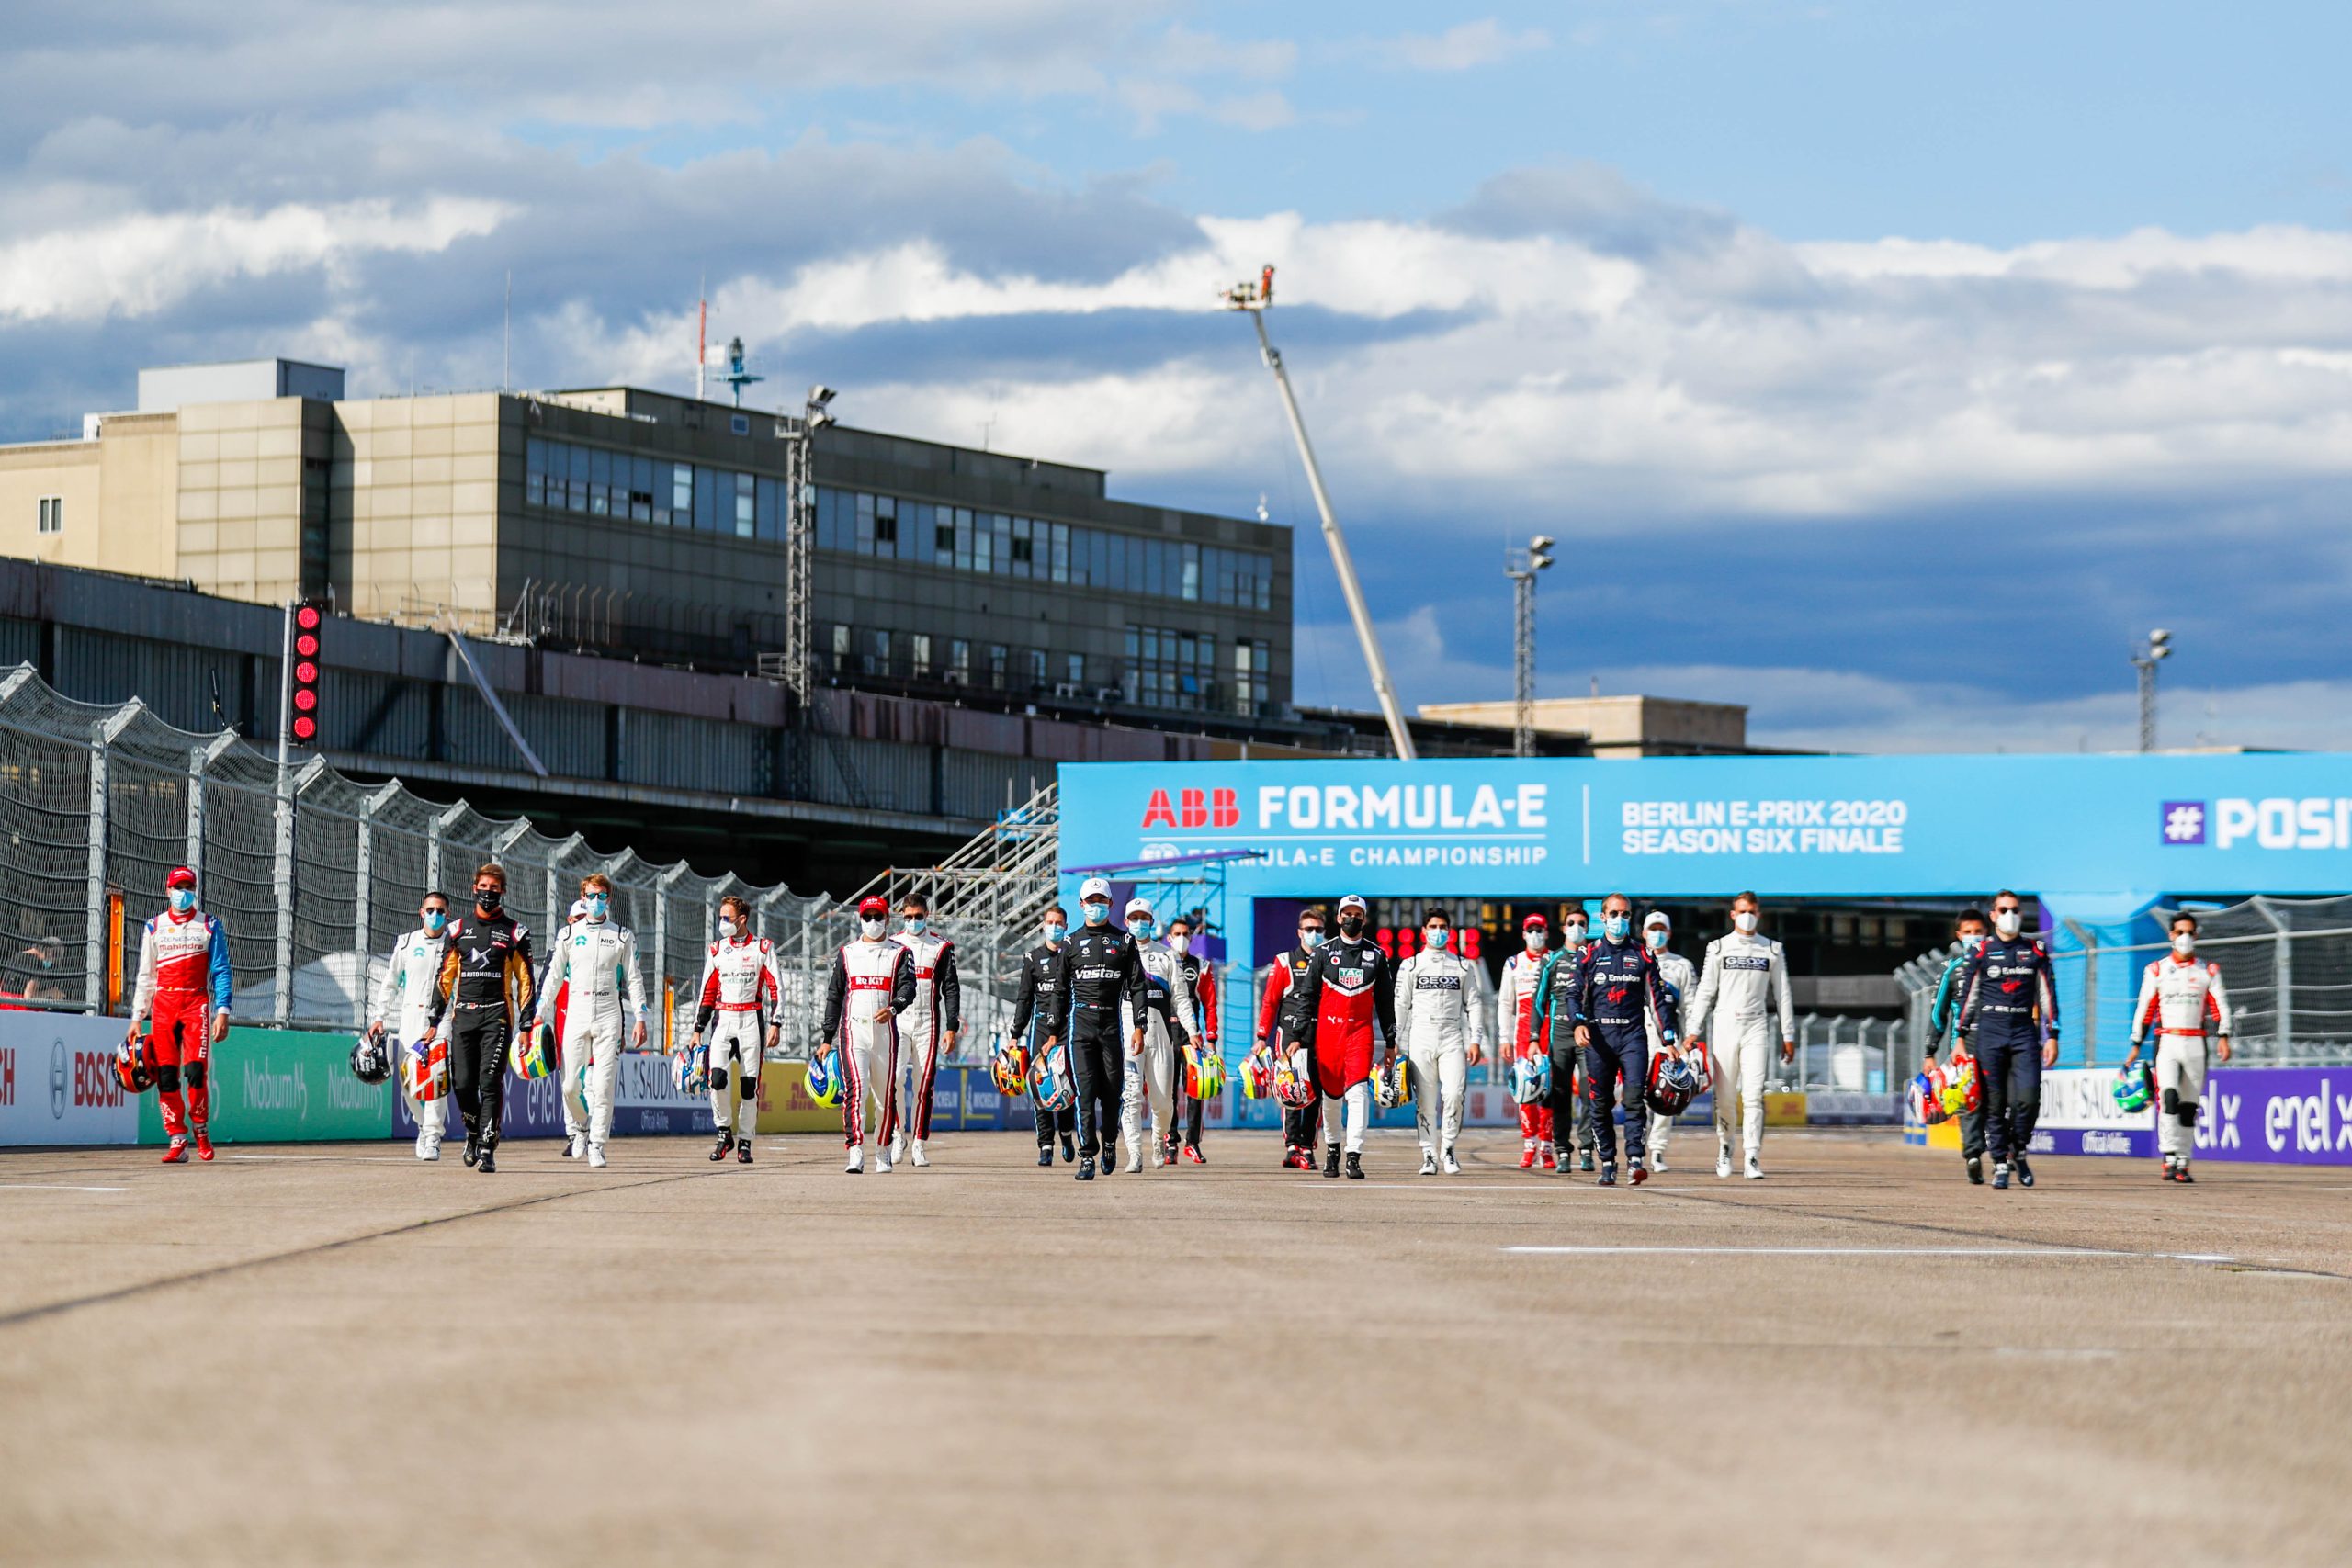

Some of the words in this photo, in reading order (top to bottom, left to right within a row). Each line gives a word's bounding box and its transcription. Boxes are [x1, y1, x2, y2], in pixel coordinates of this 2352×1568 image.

[1141, 787, 1240, 829] ABB
[1259, 784, 1548, 829] FORMULA-E
[1622, 801, 1725, 827] BERLIN
[1729, 800, 1826, 827] E-PRIX
[1830, 799, 1908, 826] 2020
[2215, 797, 2352, 850] POSI
[1622, 829, 1742, 855] SEASON
[1747, 829, 1796, 854] SIX
[1800, 828, 1903, 854] FINALE
[1349, 846, 1548, 867] CHAMPIONSHIP
[600, 937, 615, 945] NIO
[1724, 956, 1767, 965] GEOX
[1418, 976, 1459, 985] GEOX
[1608, 974, 1641, 983] Envision
[2194, 1078, 2218, 1150] el
[2265, 1077, 2332, 1154] enel
